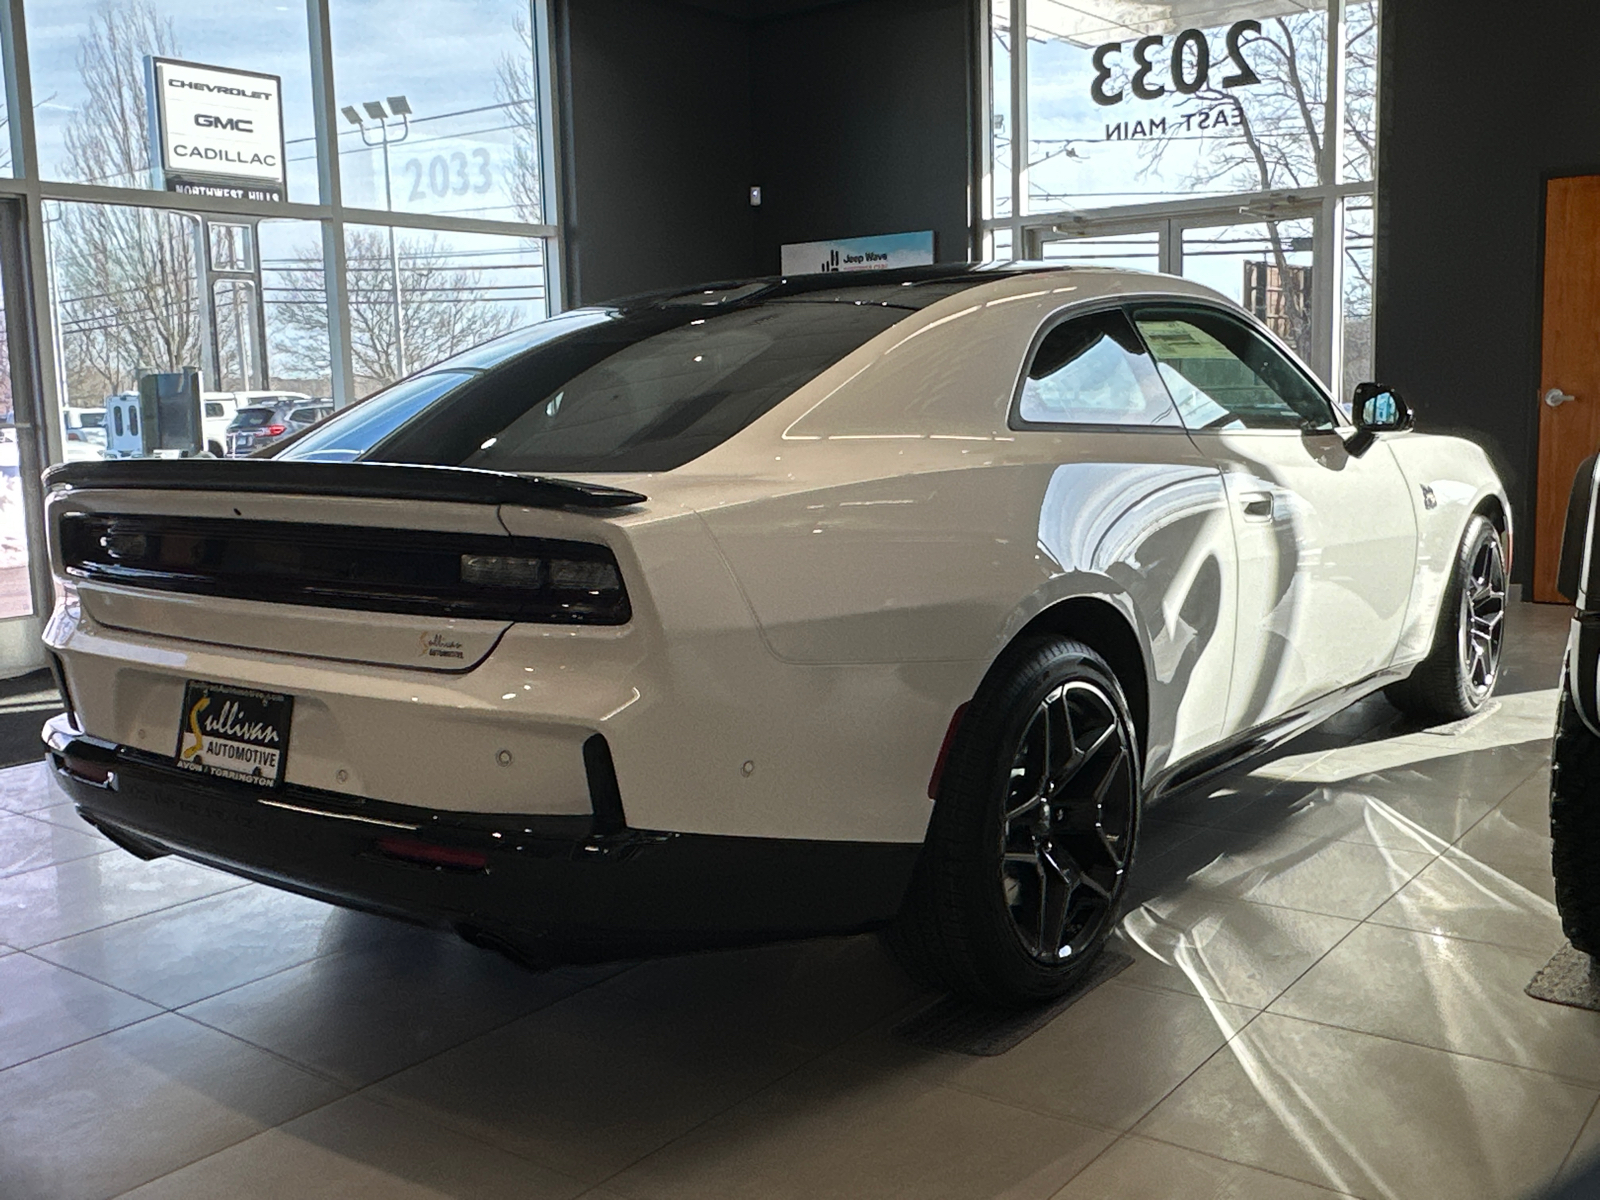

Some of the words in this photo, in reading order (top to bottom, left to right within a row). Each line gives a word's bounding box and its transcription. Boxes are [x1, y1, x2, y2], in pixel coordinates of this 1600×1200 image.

[168, 79, 272, 101] CHEVROLET
[194, 113, 253, 133] GMC
[173, 144, 277, 167] CADILLAC
[405, 147, 493, 203] 2033
[843, 254, 864, 264] Jeep
[865, 251, 888, 262] Wave
[183, 697, 279, 759] Sullivan
[206, 741, 276, 768] AUTOMOTIVE
[210, 768, 275, 787] TORRINGTON
